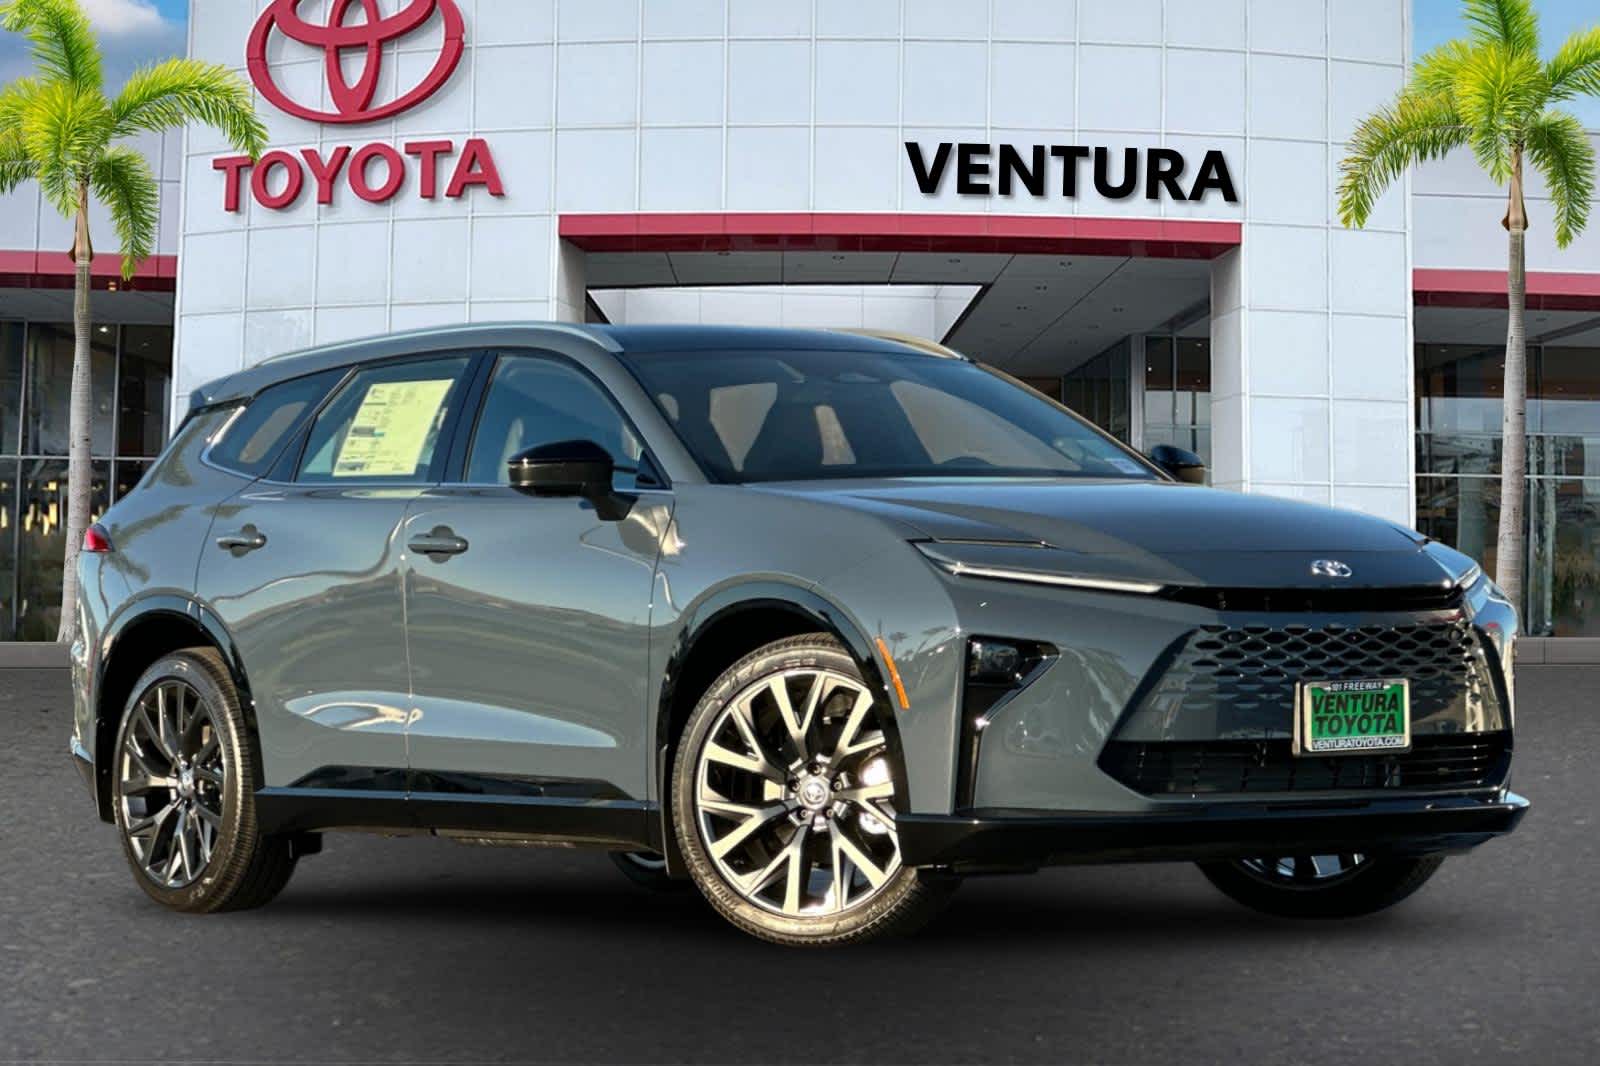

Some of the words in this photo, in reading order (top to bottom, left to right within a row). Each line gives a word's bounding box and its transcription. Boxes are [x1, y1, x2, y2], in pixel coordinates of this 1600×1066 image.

[213, 138, 505, 212] TOYOTA
[904, 142, 1238, 203] VENTURA
[1343, 682, 1382, 690] FREEWAY
[1312, 693, 1398, 713] VENTURA
[1315, 715, 1397, 734] TOYOTA
[1313, 737, 1403, 749] VENTURATOYOTA.COM
